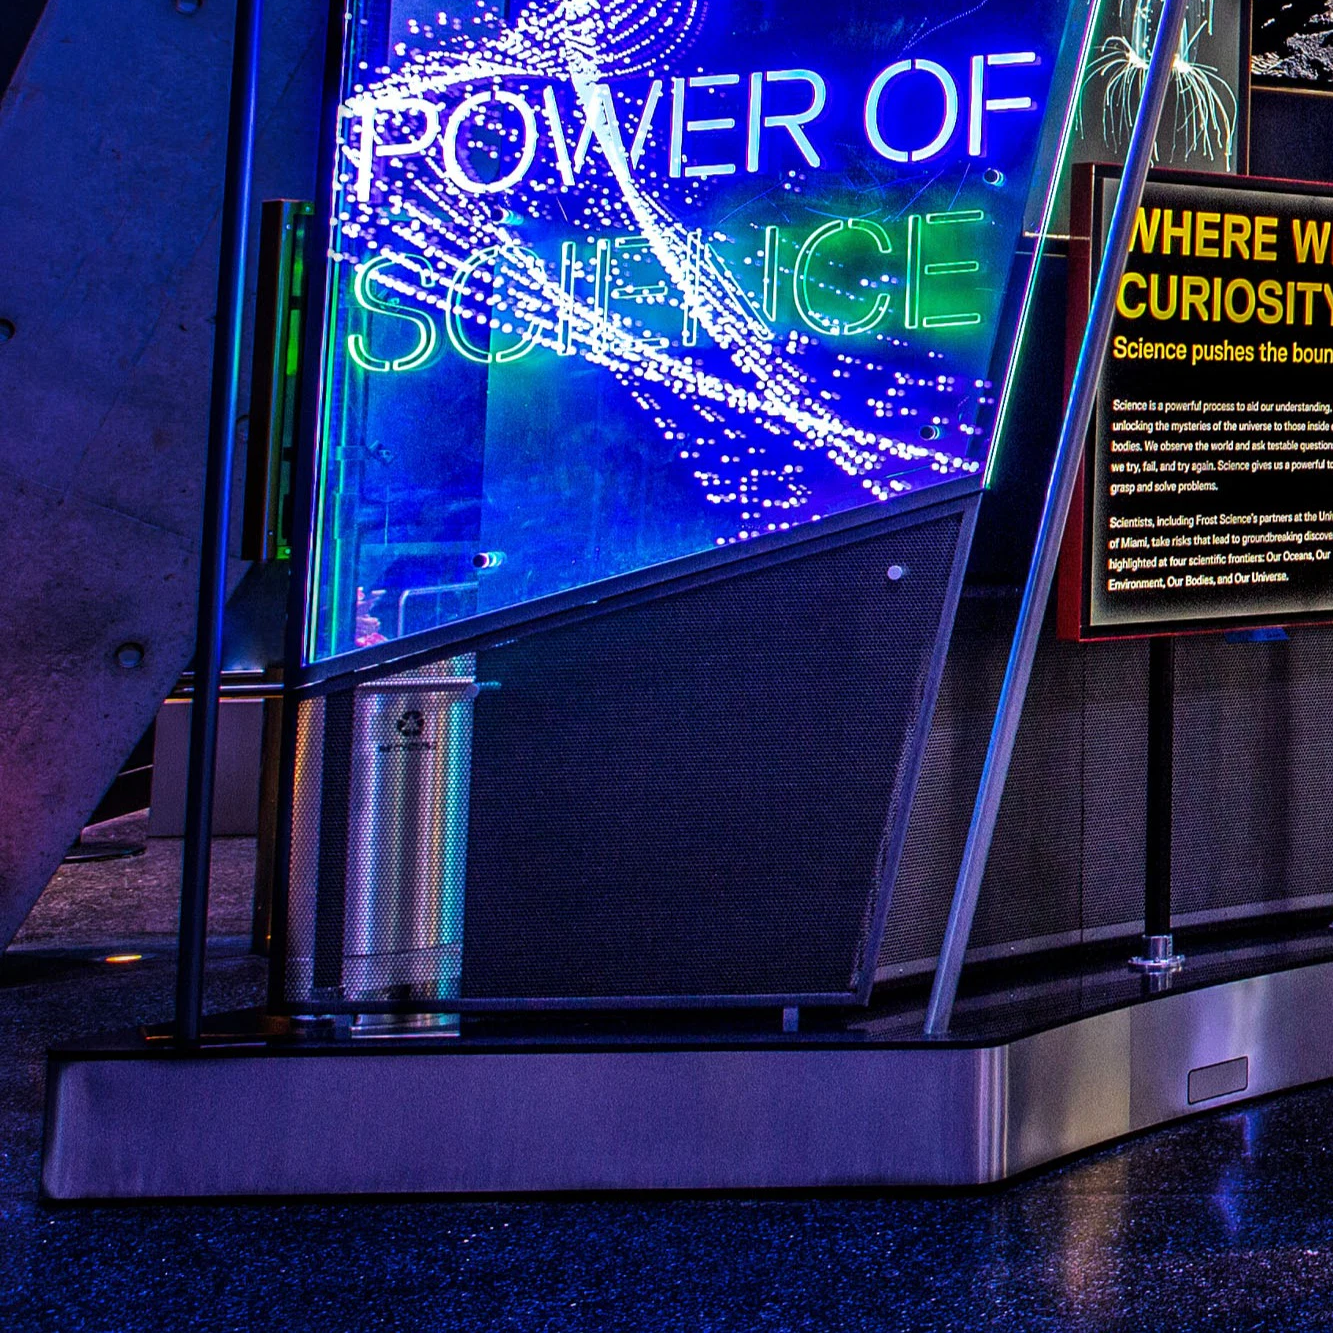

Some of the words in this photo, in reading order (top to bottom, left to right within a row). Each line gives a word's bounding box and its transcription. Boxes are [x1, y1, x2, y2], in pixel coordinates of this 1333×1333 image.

[352, 69, 826, 203] POWER
[864, 51, 1038, 162] OF
[1128, 208, 1279, 260] WHERE
[347, 209, 985, 372] SCIENCE
[1113, 336, 1188, 360] Science
[1191, 340, 1255, 364] pushes
[1259, 341, 1288, 363] the
[1112, 399, 1148, 411] Science
[1148, 399, 1157, 411] is
[1157, 401, 1164, 411] a
[1164, 400, 1202, 413] powerful
[1202, 402, 1236, 413] process
[1236, 401, 1246, 412] to
[1246, 401, 1260, 412] aid
[1260, 403, 1275, 412] our
[1275, 401, 1333, 414] understanding,
[1109, 516, 1155, 529] Scientists,
[1156, 515, 1195, 528] including
[1195, 514, 1218, 526] Frost
[1219, 513, 1258, 525] Science's
[1259, 513, 1293, 526] partners
[1293, 512, 1303, 523] at
[1303, 511, 1318, 522] the
[1109, 537, 1121, 550] of
[1120, 537, 1151, 549] Miami,
[1150, 535, 1171, 547] take
[1171, 535, 1192, 547] risks
[1193, 534, 1211, 546] that
[1212, 533, 1230, 545] lead
[1231, 534, 1241, 544] to
[1241, 531, 1303, 546] groundbreaking
[1108, 557, 1158, 571] highlighted
[1158, 557, 1168, 568] at
[1169, 555, 1188, 567] four
[1188, 554, 1227, 566] scientific
[1227, 553, 1266, 564] frontiers:
[1266, 551, 1282, 563] Our
[1282, 550, 1315, 562] Oceans,
[1315, 549, 1332, 560] Our
[1107, 578, 1166, 591] Environment,
[1166, 575, 1184, 588] Our
[1185, 574, 1217, 587] Bodies,
[1216, 573, 1234, 585] and
[1234, 572, 1251, 584] Our
[1251, 571, 1289, 583] Universe.
